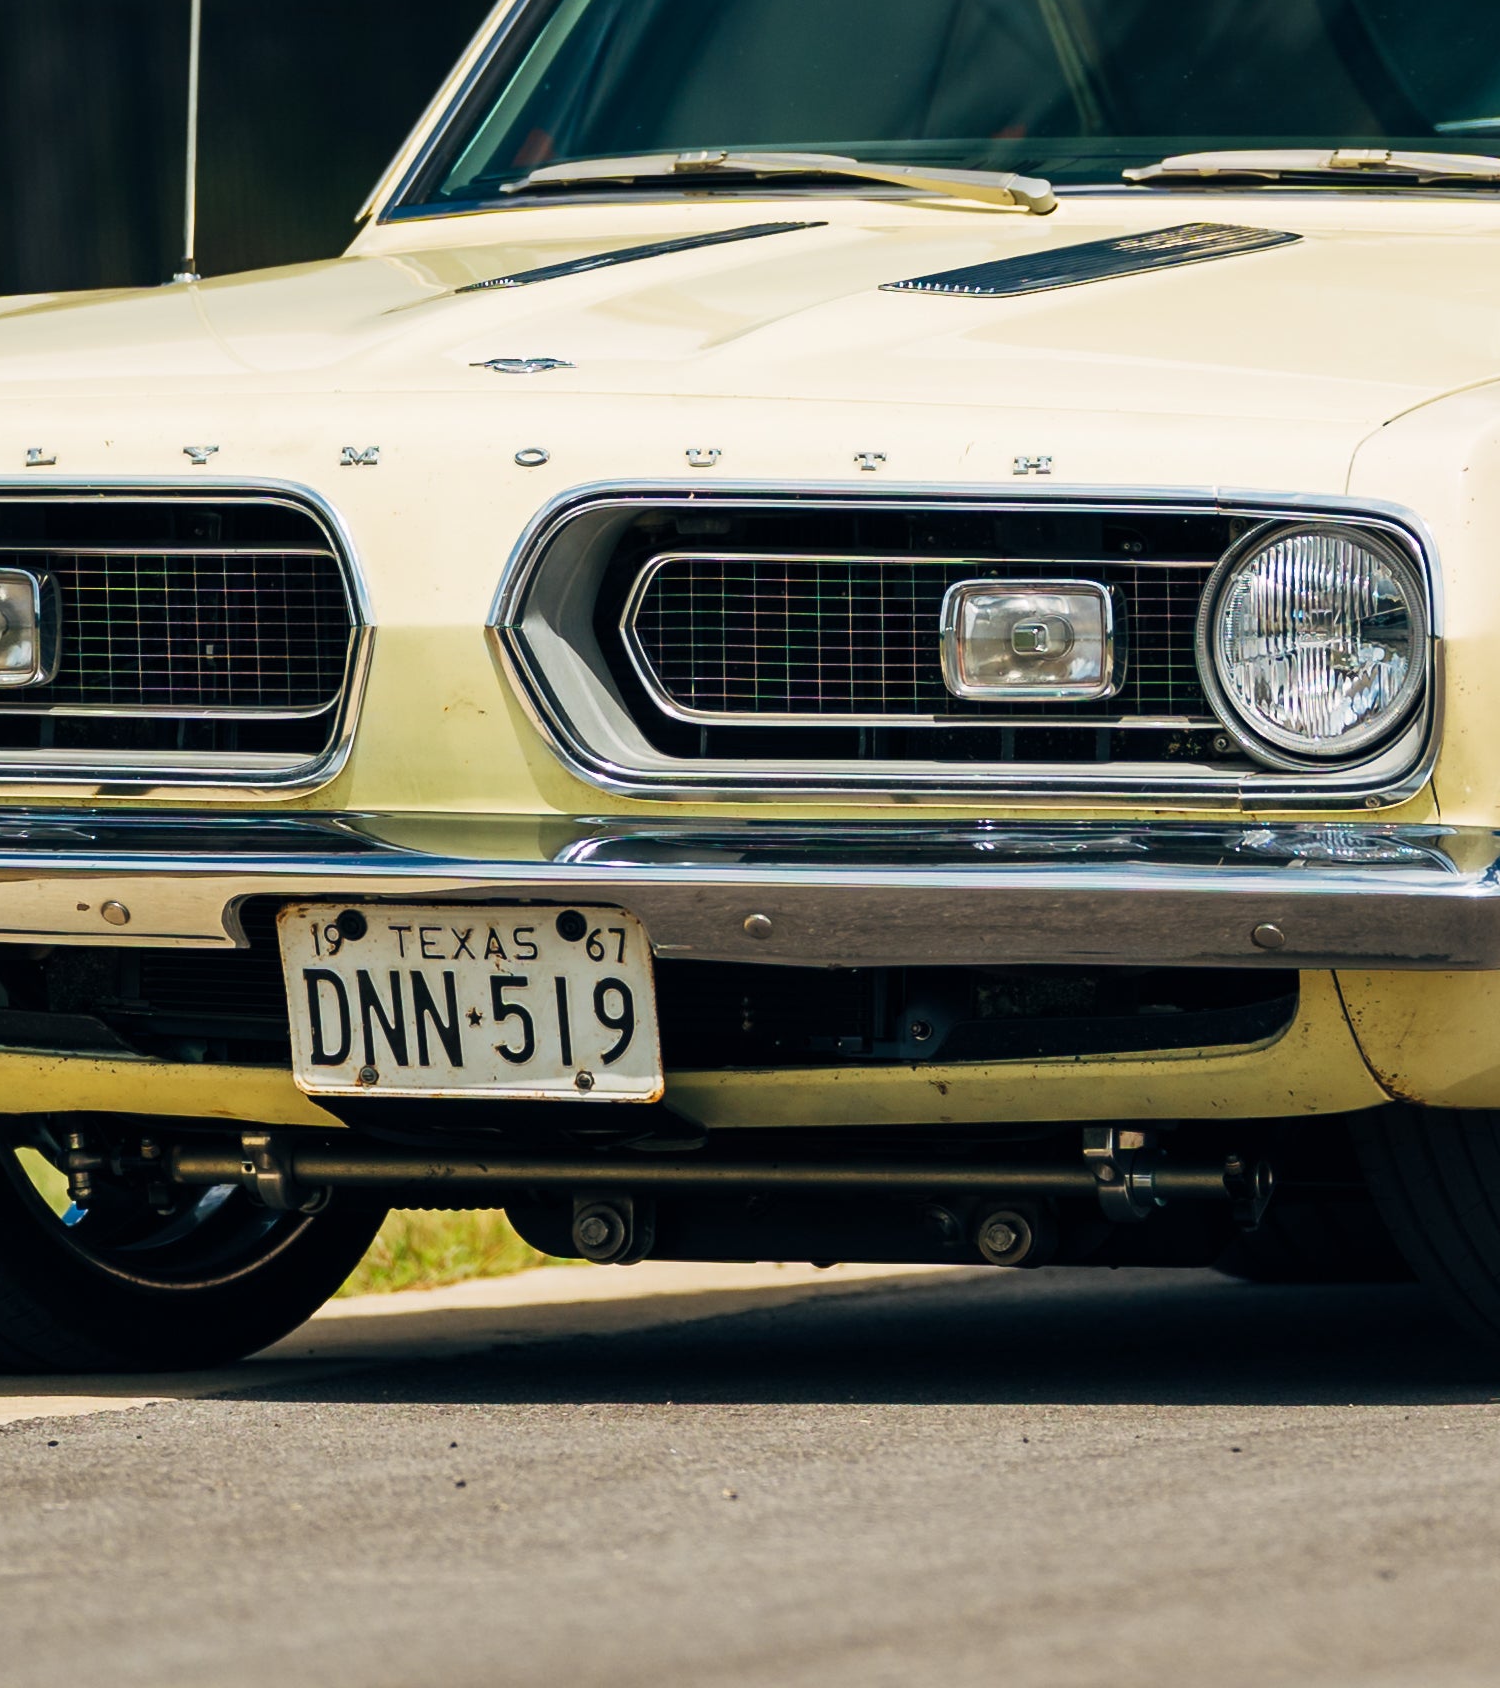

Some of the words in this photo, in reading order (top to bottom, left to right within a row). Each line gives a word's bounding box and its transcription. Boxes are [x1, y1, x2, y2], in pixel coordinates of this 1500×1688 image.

[310, 922, 344, 957] 19
[389, 924, 539, 960] TEXAS
[585, 927, 626, 964] 67
